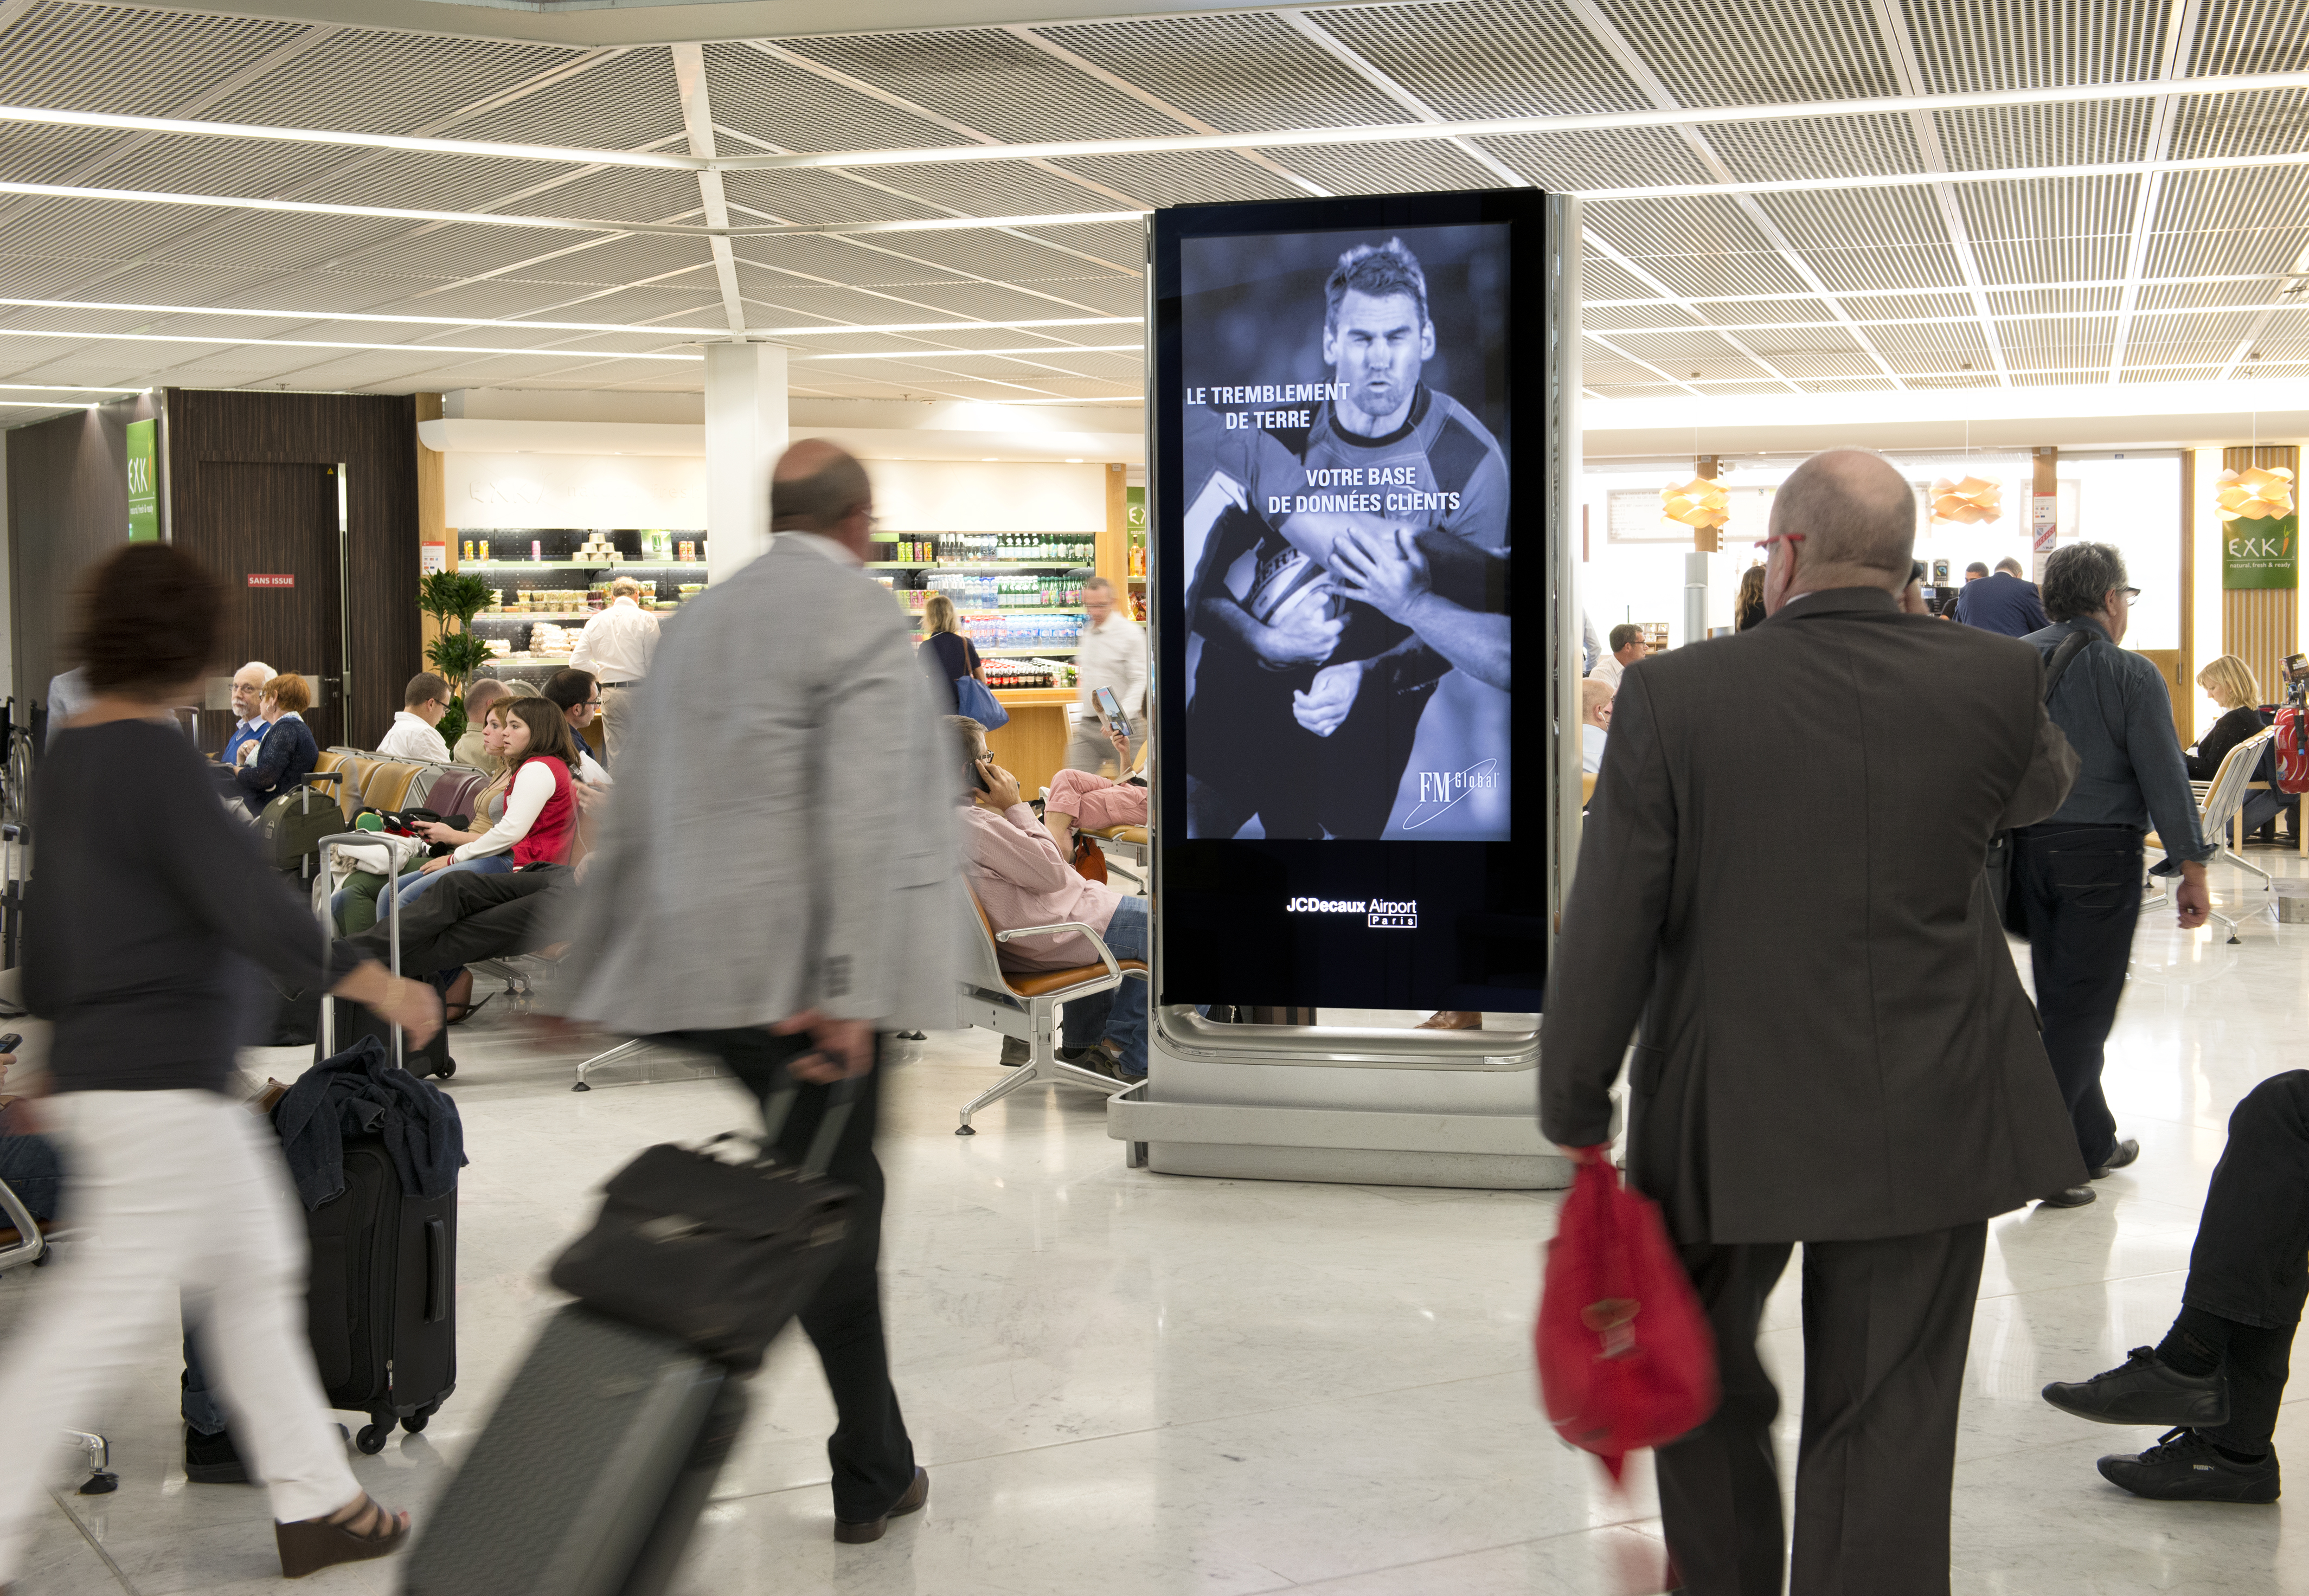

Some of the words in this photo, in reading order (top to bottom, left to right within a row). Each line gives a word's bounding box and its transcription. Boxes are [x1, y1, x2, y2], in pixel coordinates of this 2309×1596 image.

[1186, 388, 1206, 404] LE
[1211, 383, 1350, 404] TREMBLEMENT
[1226, 412, 1249, 429] DE
[1254, 410, 1310, 428] TERRE
[1306, 468, 1363, 487] VOTRE
[1368, 467, 1416, 485] BASE
[1268, 496, 1291, 513] DE
[1296, 490, 1381, 512] DONNÉES
[1386, 492, 1460, 511] CLIENTS
[1419, 772, 1451, 802] FM
[1454, 772, 1497, 788] Global
[1286, 898, 1366, 912] JCDecaux
[1369, 898, 1417, 915] Airport
[1372, 916, 1414, 925] Paris
